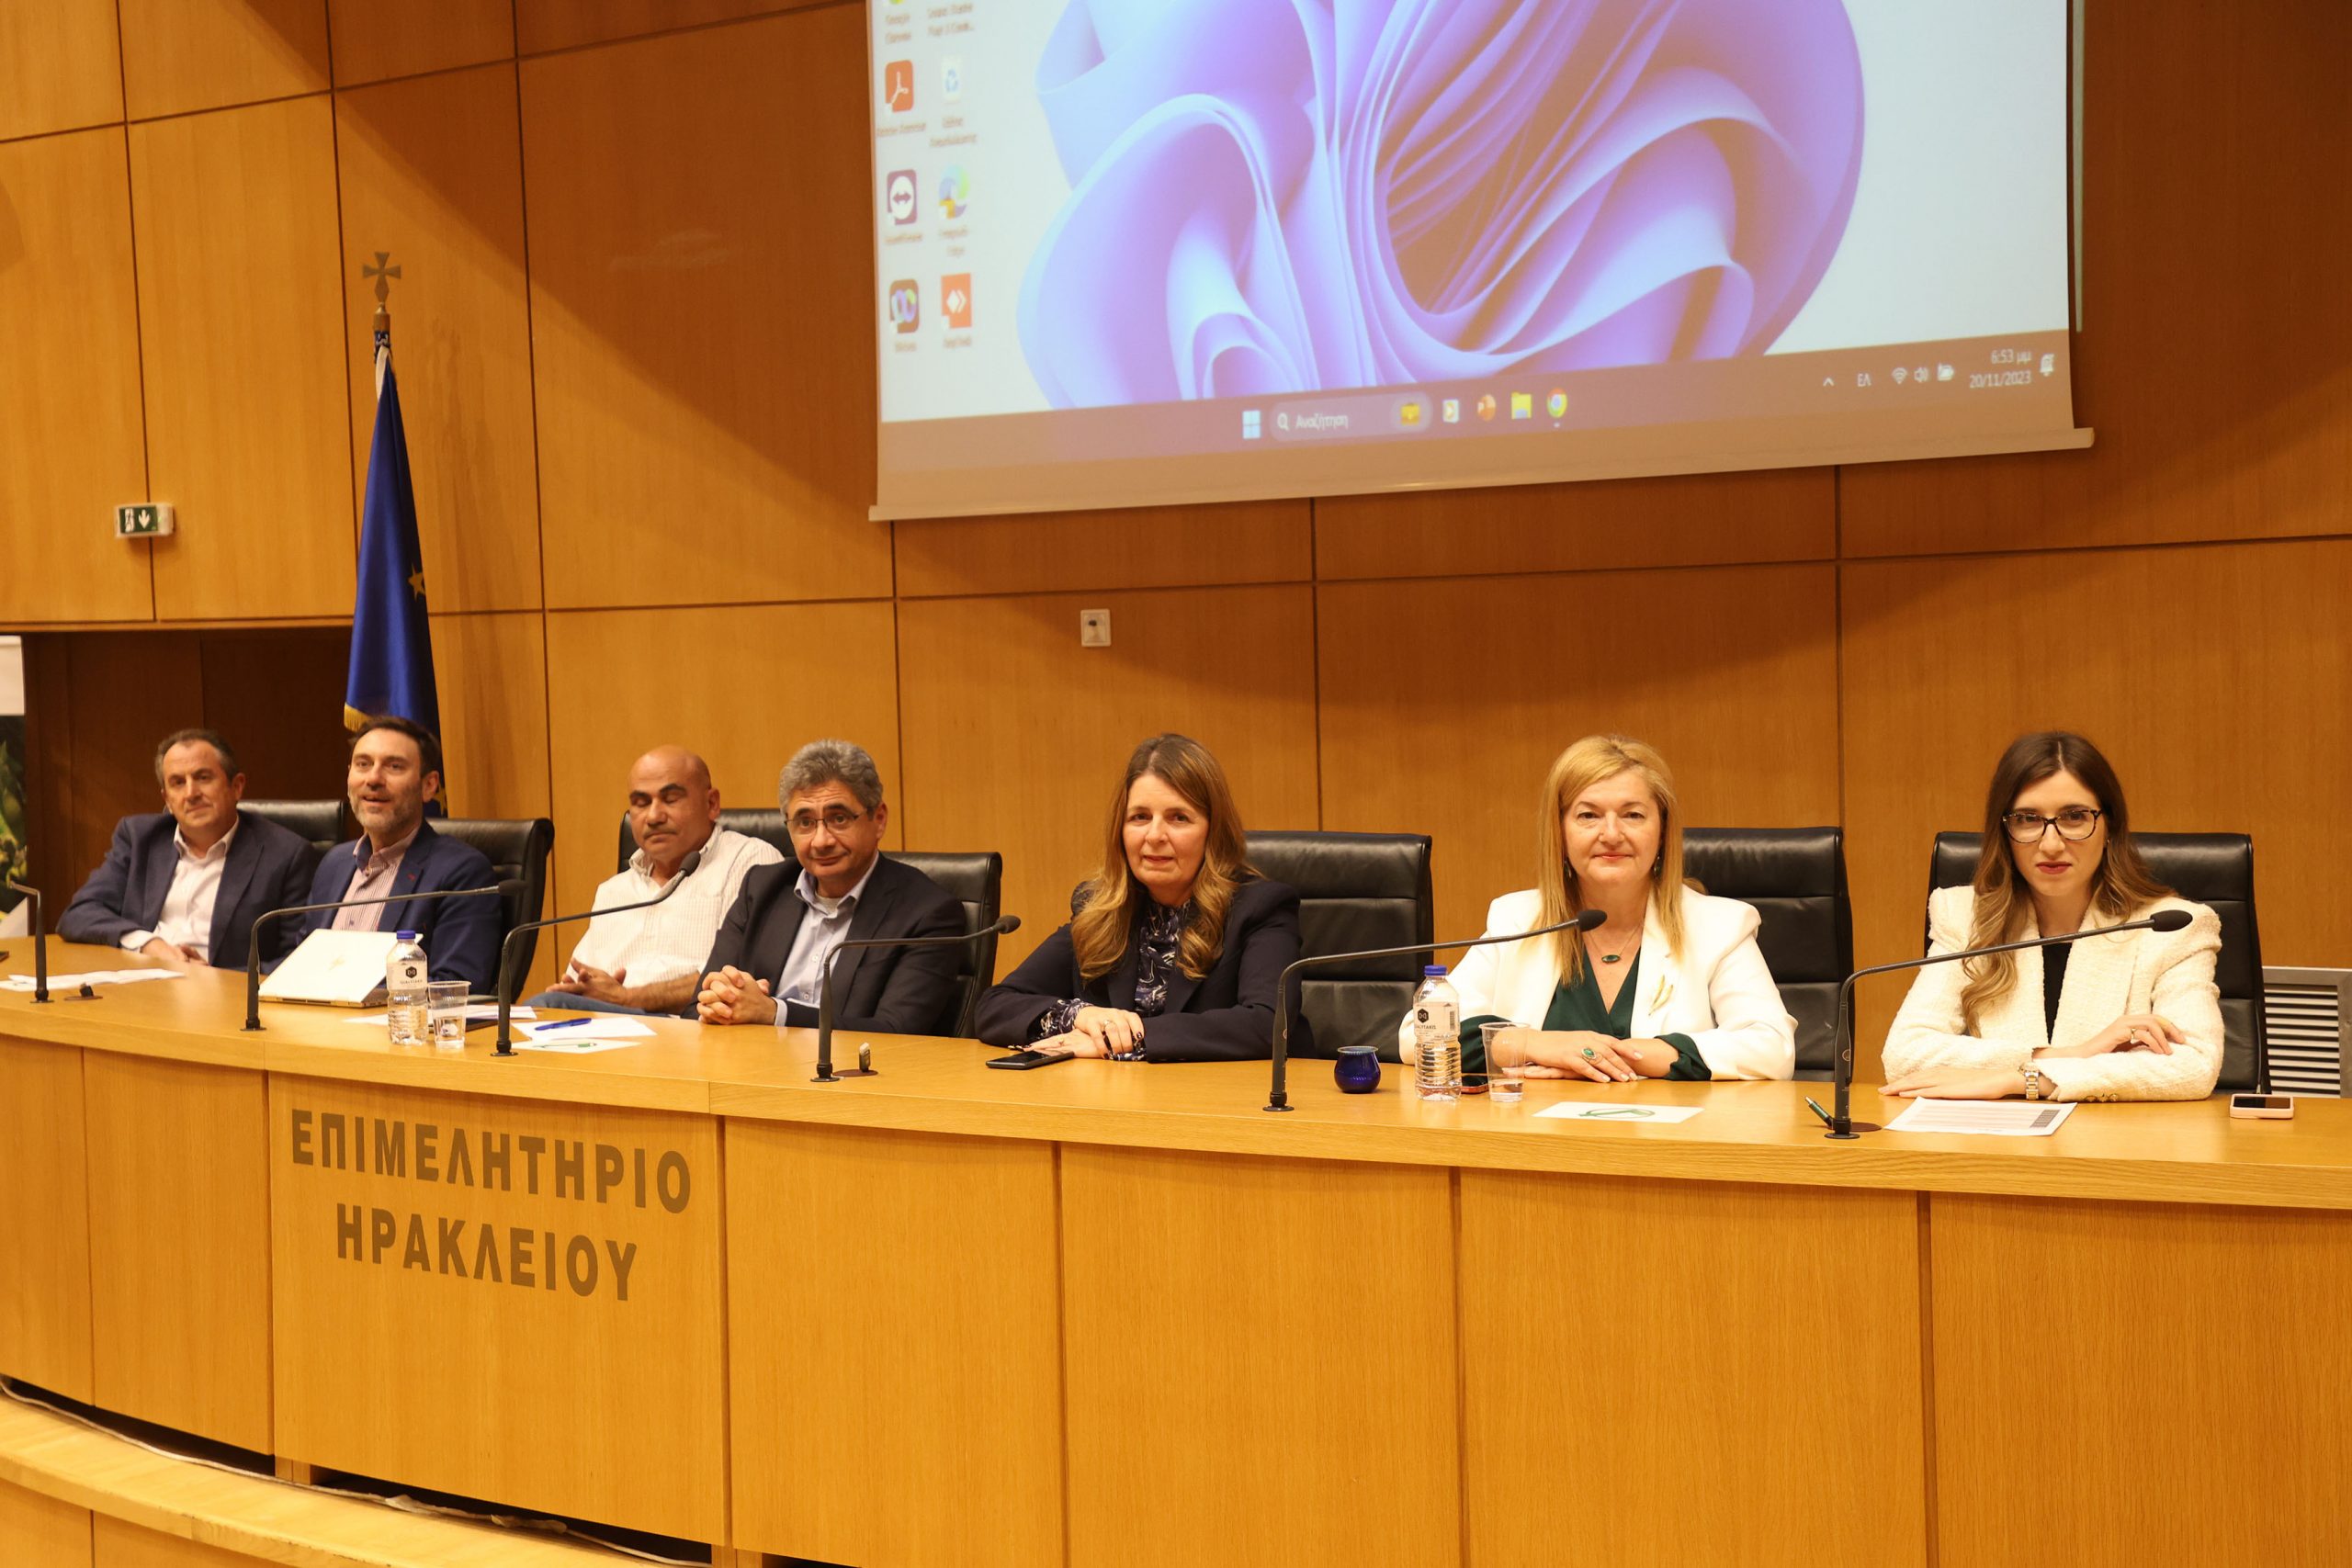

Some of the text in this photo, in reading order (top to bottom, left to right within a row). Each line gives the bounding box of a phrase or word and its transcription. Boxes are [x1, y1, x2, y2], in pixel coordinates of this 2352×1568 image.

[1969, 369, 2031, 389] 20/11/2023
[1991, 349, 2013, 364] 6:53
[291, 1108, 691, 1213] ΕΠΙΜΕΛΗΤΗΡΙΟ
[336, 1203, 637, 1301] ΗΡΑΚΛΕΙΟΥ
